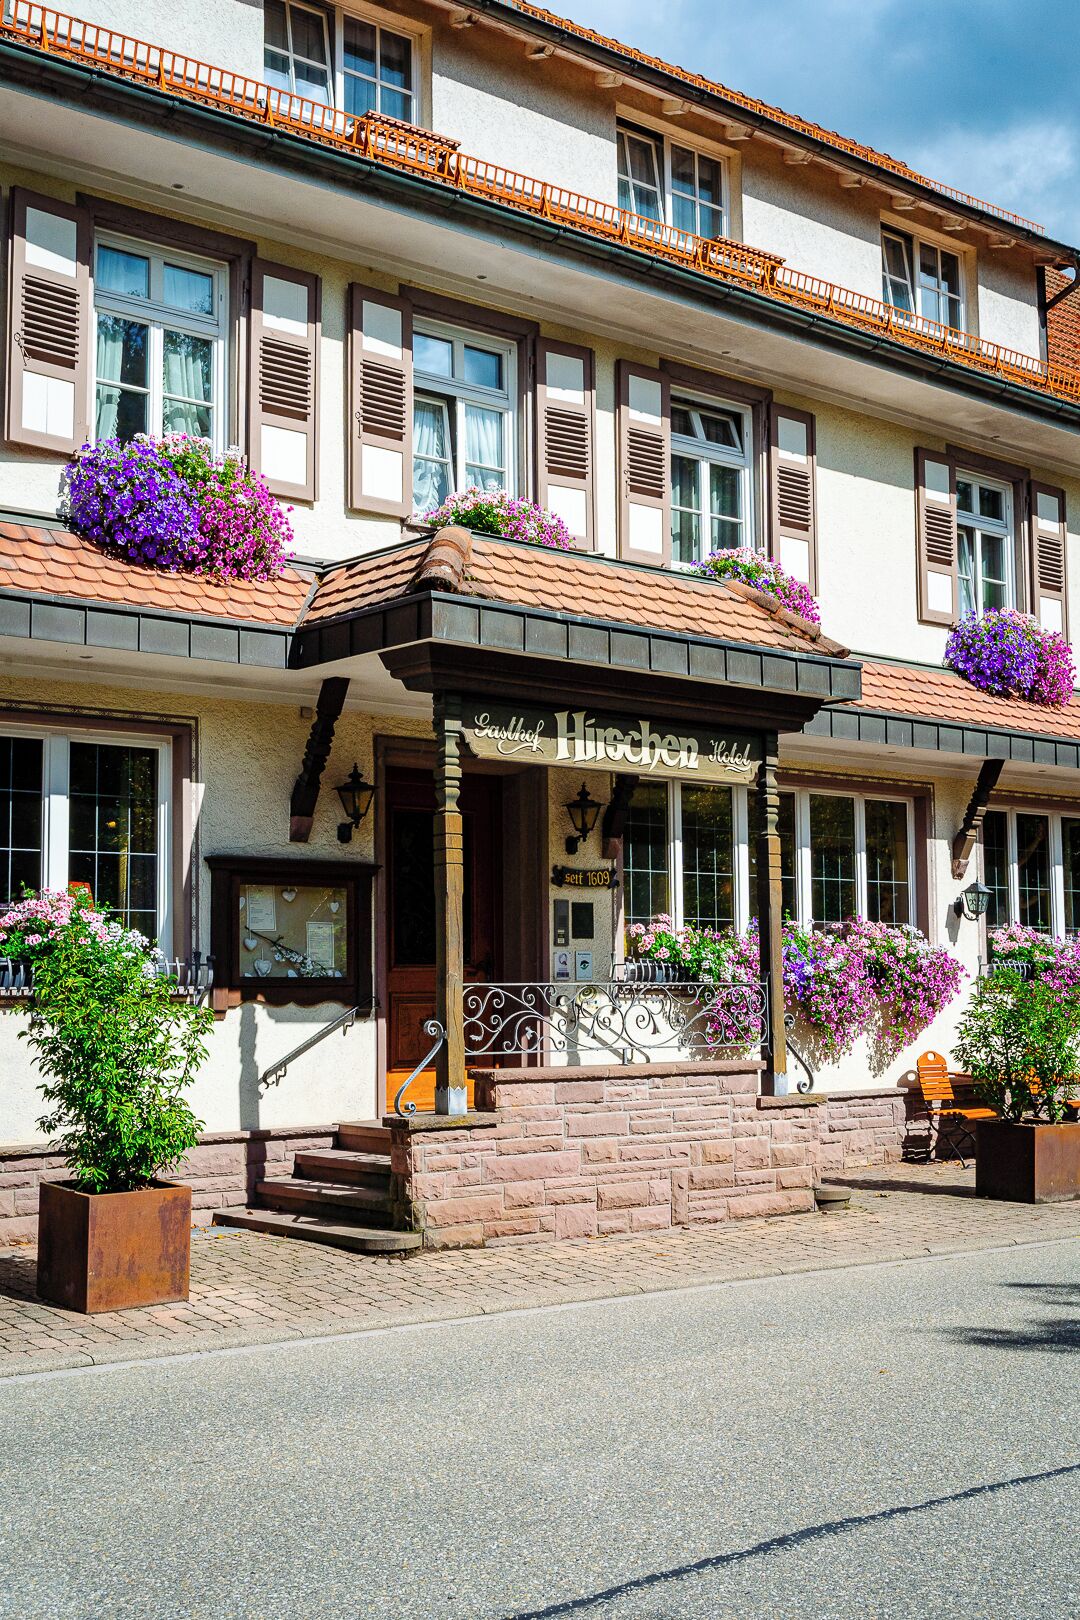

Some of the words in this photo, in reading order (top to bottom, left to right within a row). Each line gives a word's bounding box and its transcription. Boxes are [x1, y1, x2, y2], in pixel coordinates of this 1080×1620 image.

[474, 713, 545, 754] Gasthof
[555, 710, 699, 771] Hirschen
[708, 739, 752, 771] Hotel
[564, 872, 583, 885] seit
[586, 870, 610, 887] 1609
